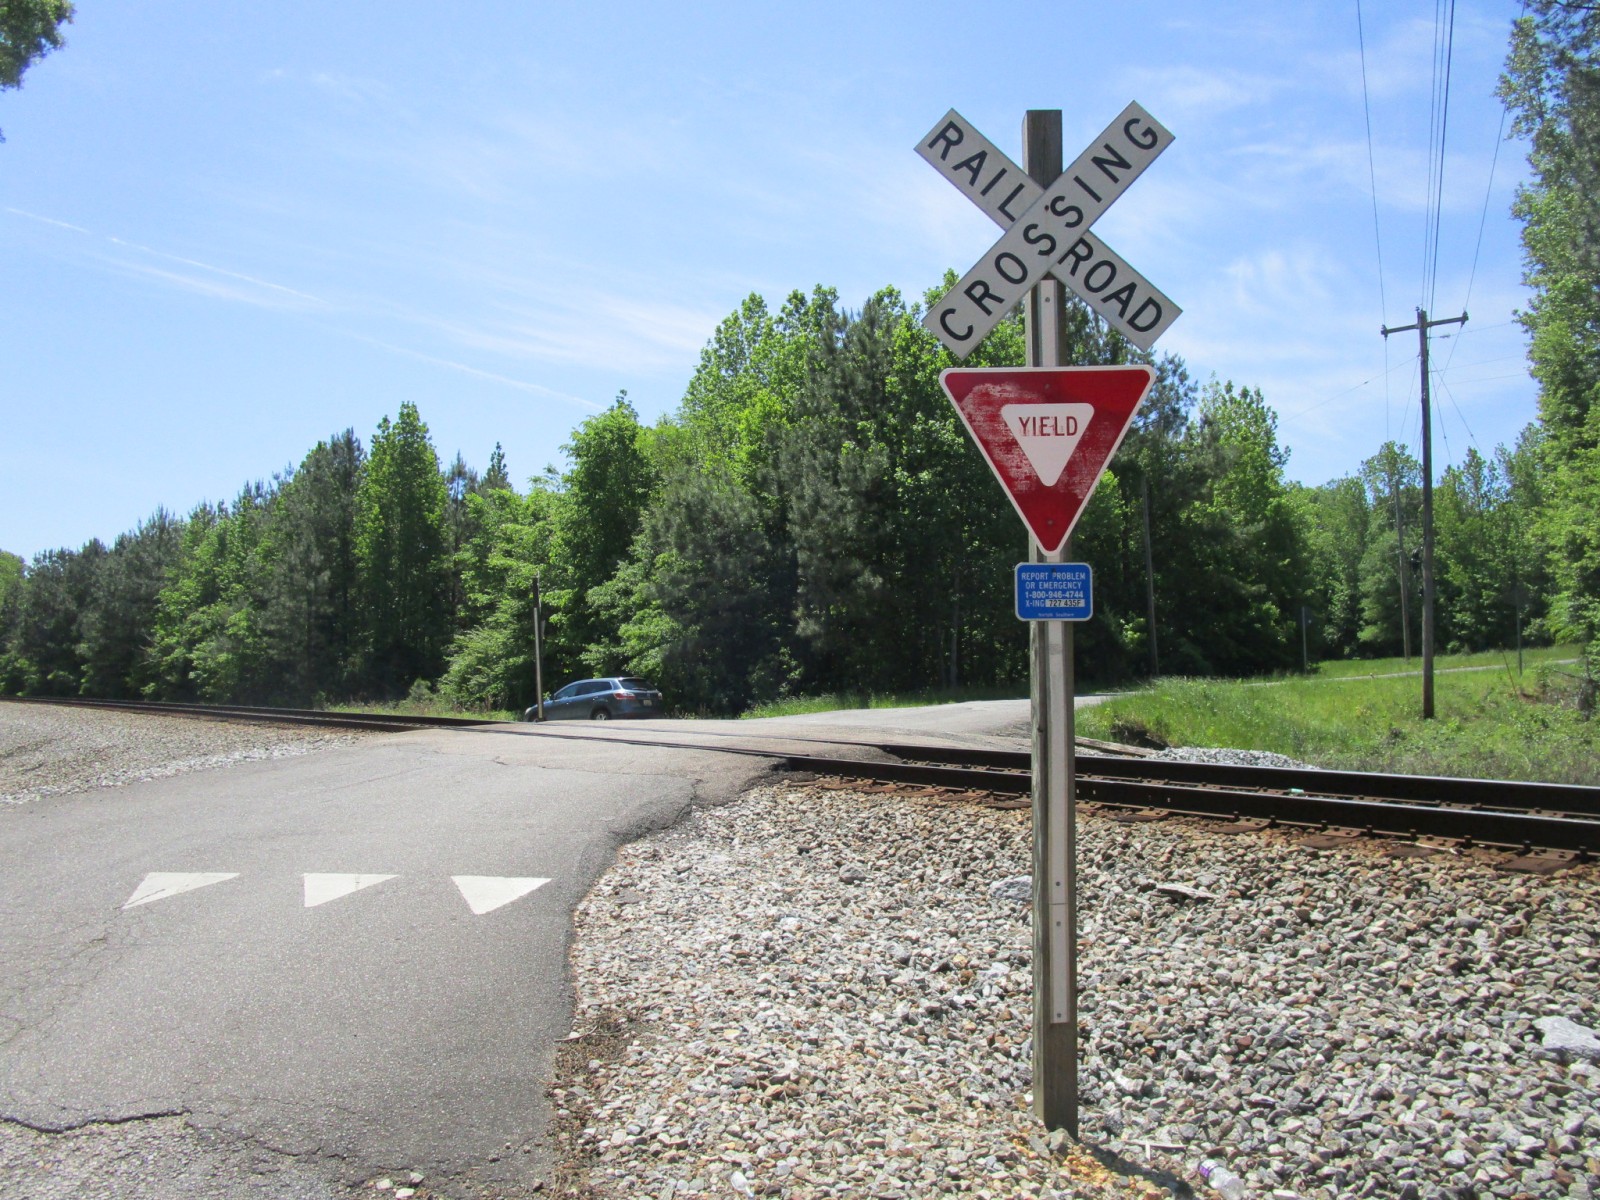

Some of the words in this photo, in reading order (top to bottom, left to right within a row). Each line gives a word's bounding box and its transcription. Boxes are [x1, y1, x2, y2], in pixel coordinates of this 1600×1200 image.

[928, 120, 1025, 223] RAIL
[1057, 236, 1162, 333] ROAD
[939, 117, 1159, 341] CROSSING
[1018, 416, 1078, 436] YIELD
[1021, 572, 1049, 580] REPORT
[1052, 572, 1086, 580] PROBLEM
[1025, 581, 1036, 590] OR
[1039, 581, 1082, 590] EMERGENCY
